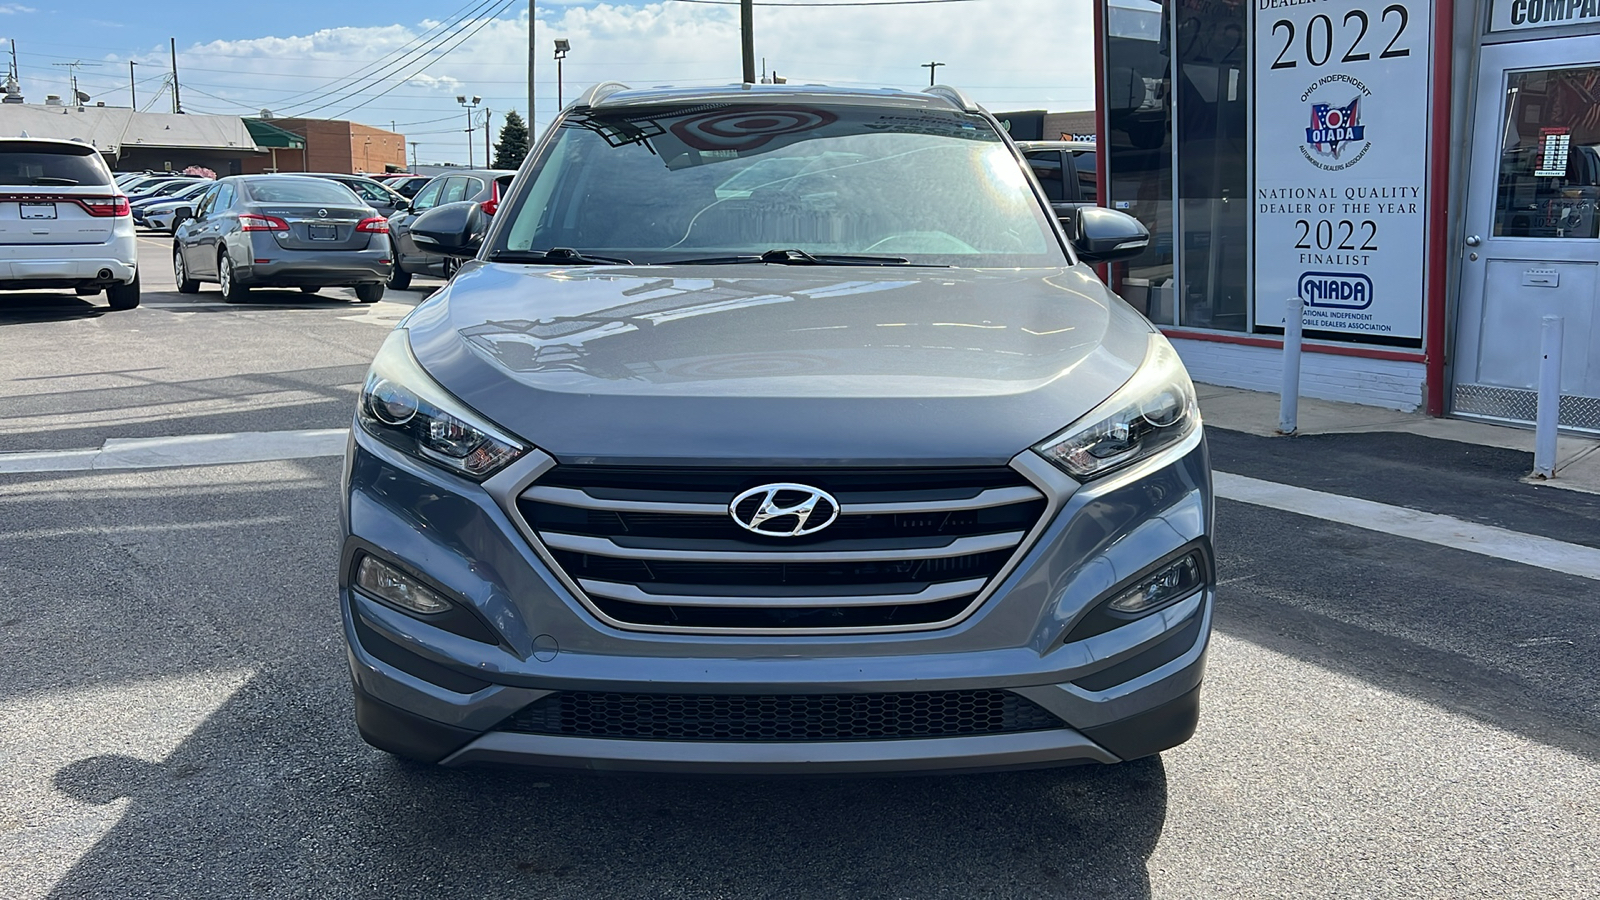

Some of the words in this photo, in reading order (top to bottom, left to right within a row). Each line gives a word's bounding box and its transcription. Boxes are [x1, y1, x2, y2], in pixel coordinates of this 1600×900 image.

[1511, 0, 1600, 25] COMPA
[1270, 4, 1410, 70] 2022
[1301, 83, 1318, 102] OHIO
[1319, 74, 1372, 97] INDEPENDENT
[1312, 128, 1355, 142] OIADA
[1299, 145, 1323, 169] AUTOMOBILE
[1345, 141, 1372, 168] ASSOCIATION
[1258, 187, 1338, 199] NATIONAL
[1345, 187, 1420, 200] QUALITY
[1260, 203, 1312, 214] DEALER
[1318, 203, 1336, 213] OF
[1342, 203, 1371, 214] THE
[1378, 203, 1417, 214] YEAR
[1294, 219, 1378, 251] 2022
[1300, 254, 1370, 265] FINALIST
[1304, 280, 1365, 302] NIADA
[1303, 310, 1329, 318] ATIONAL
[1330, 312, 1373, 320] INDEPENDENT
[1321, 320, 1346, 328] DEALERS
[1348, 322, 1391, 332] ASSOCIATION
